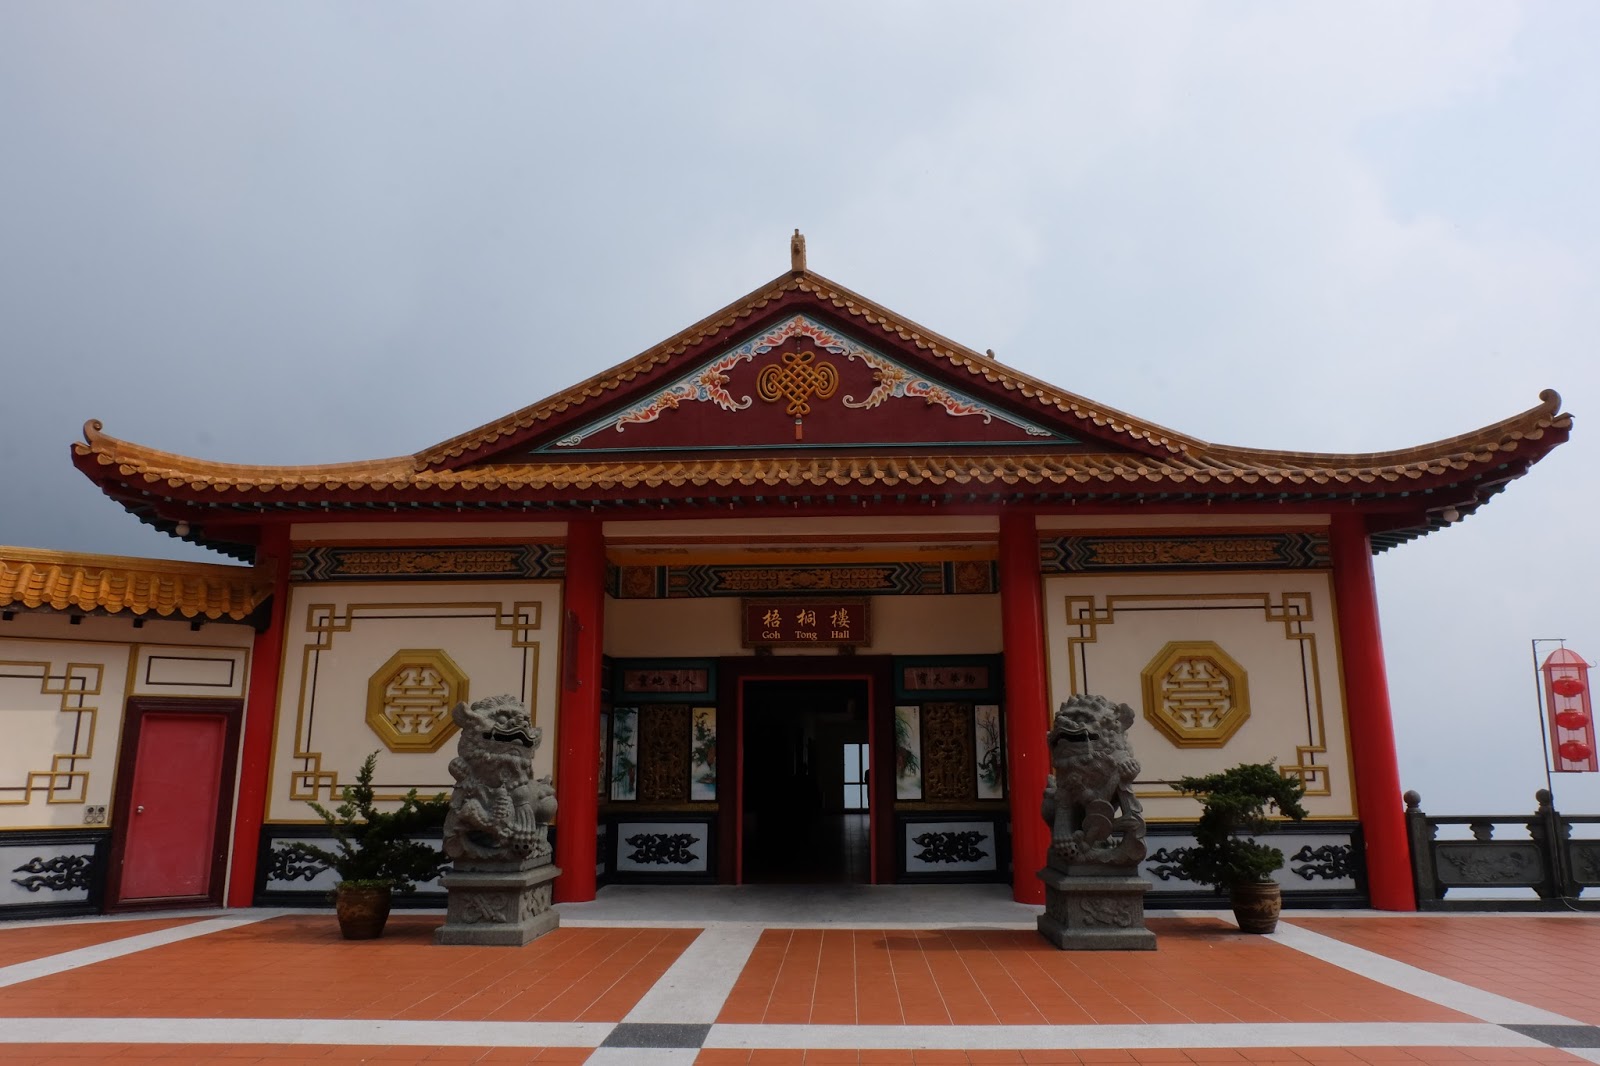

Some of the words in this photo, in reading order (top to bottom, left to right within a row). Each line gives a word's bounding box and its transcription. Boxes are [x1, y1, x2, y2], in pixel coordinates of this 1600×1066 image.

[762, 608, 851, 629] 梧桐樓
[761, 630, 781, 640] Goh
[794, 630, 818, 641] Tong
[831, 630, 850, 639] Hall
